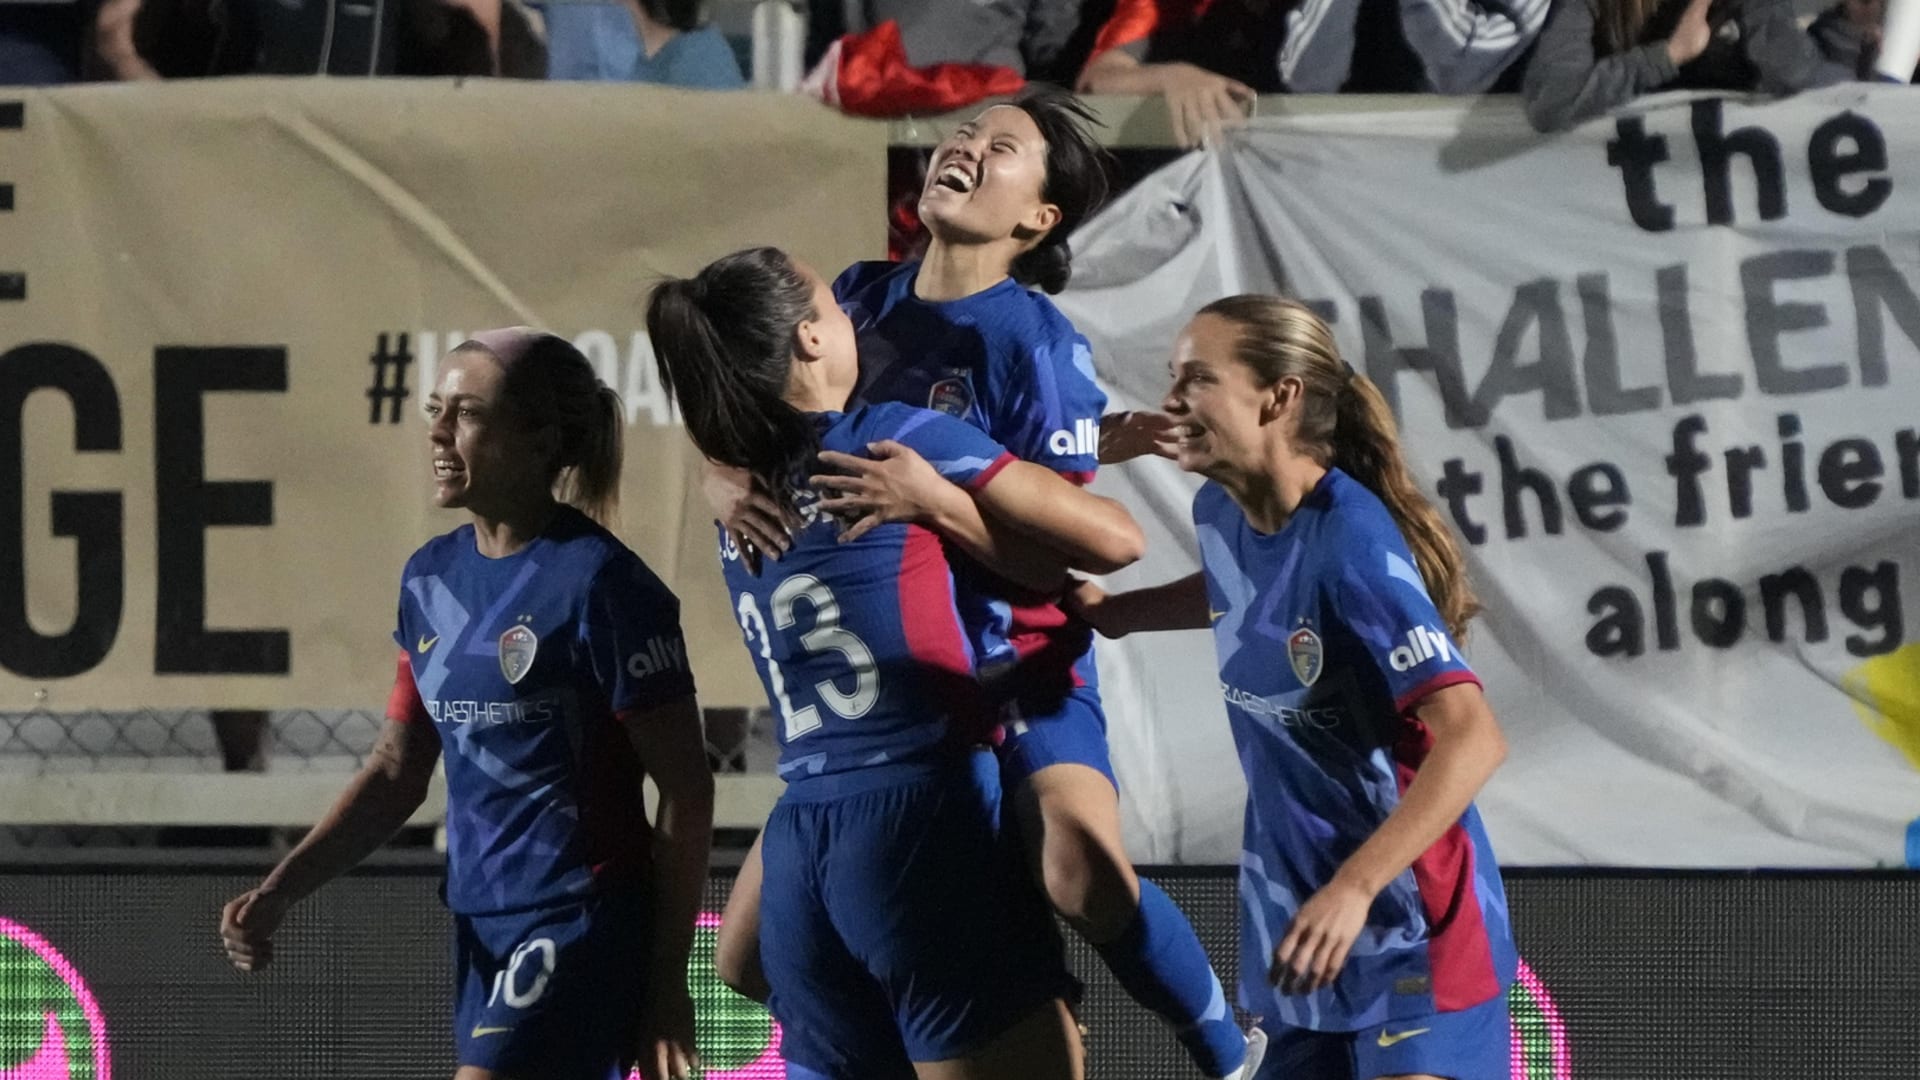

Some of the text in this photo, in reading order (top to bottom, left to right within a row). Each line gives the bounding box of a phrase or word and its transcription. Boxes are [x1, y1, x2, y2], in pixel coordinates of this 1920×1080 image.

[1607, 99, 1893, 231] the
[1306, 245, 1920, 429] HALLEN
[0, 343, 290, 679] GE
[1437, 436, 1632, 545] the
[627, 635, 682, 679] ally
[738, 573, 880, 743] 23
[1390, 625, 1451, 671] ally
[1585, 551, 1903, 657] along
[487, 938, 556, 1009] 10
